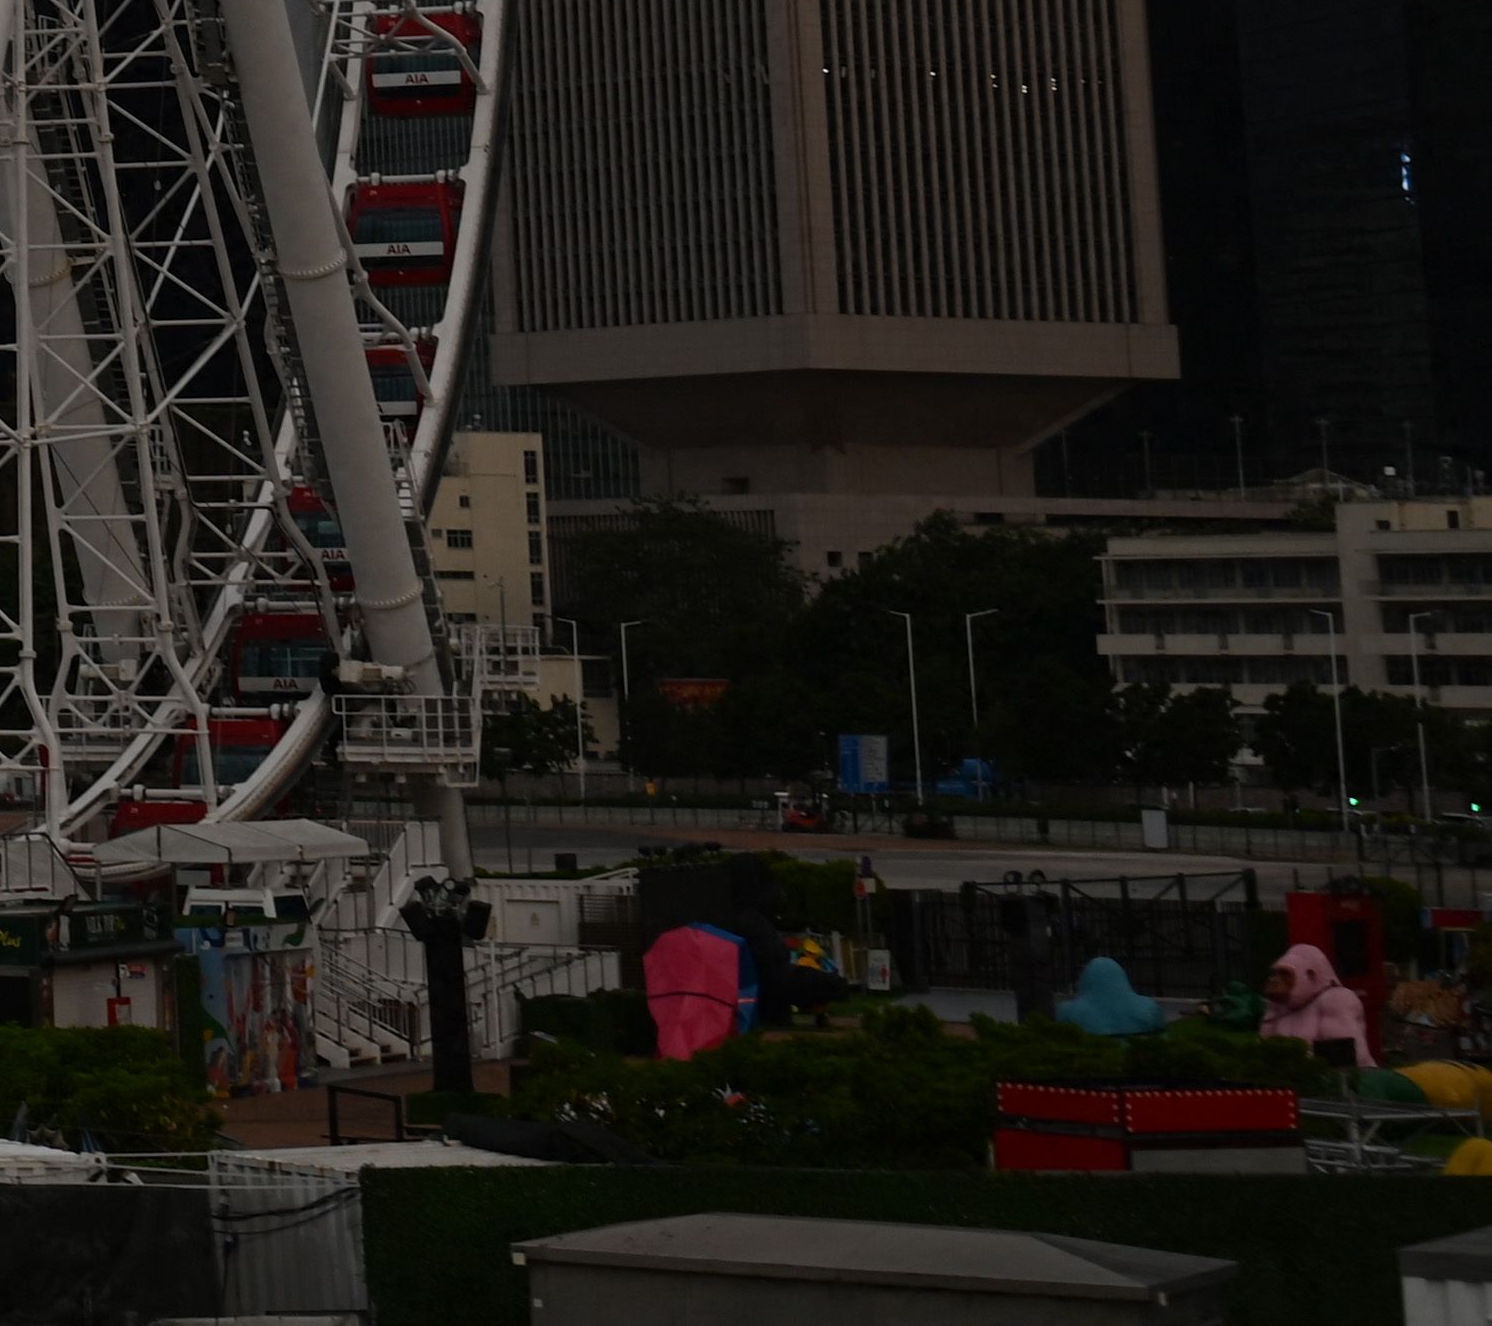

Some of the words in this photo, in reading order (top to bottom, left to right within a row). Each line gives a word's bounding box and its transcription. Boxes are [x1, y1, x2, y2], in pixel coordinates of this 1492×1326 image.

[405, 74, 429, 85] AIA
[387, 244, 411, 255] AIA
[321, 548, 346, 561] AIA
[273, 679, 299, 690] AIA
